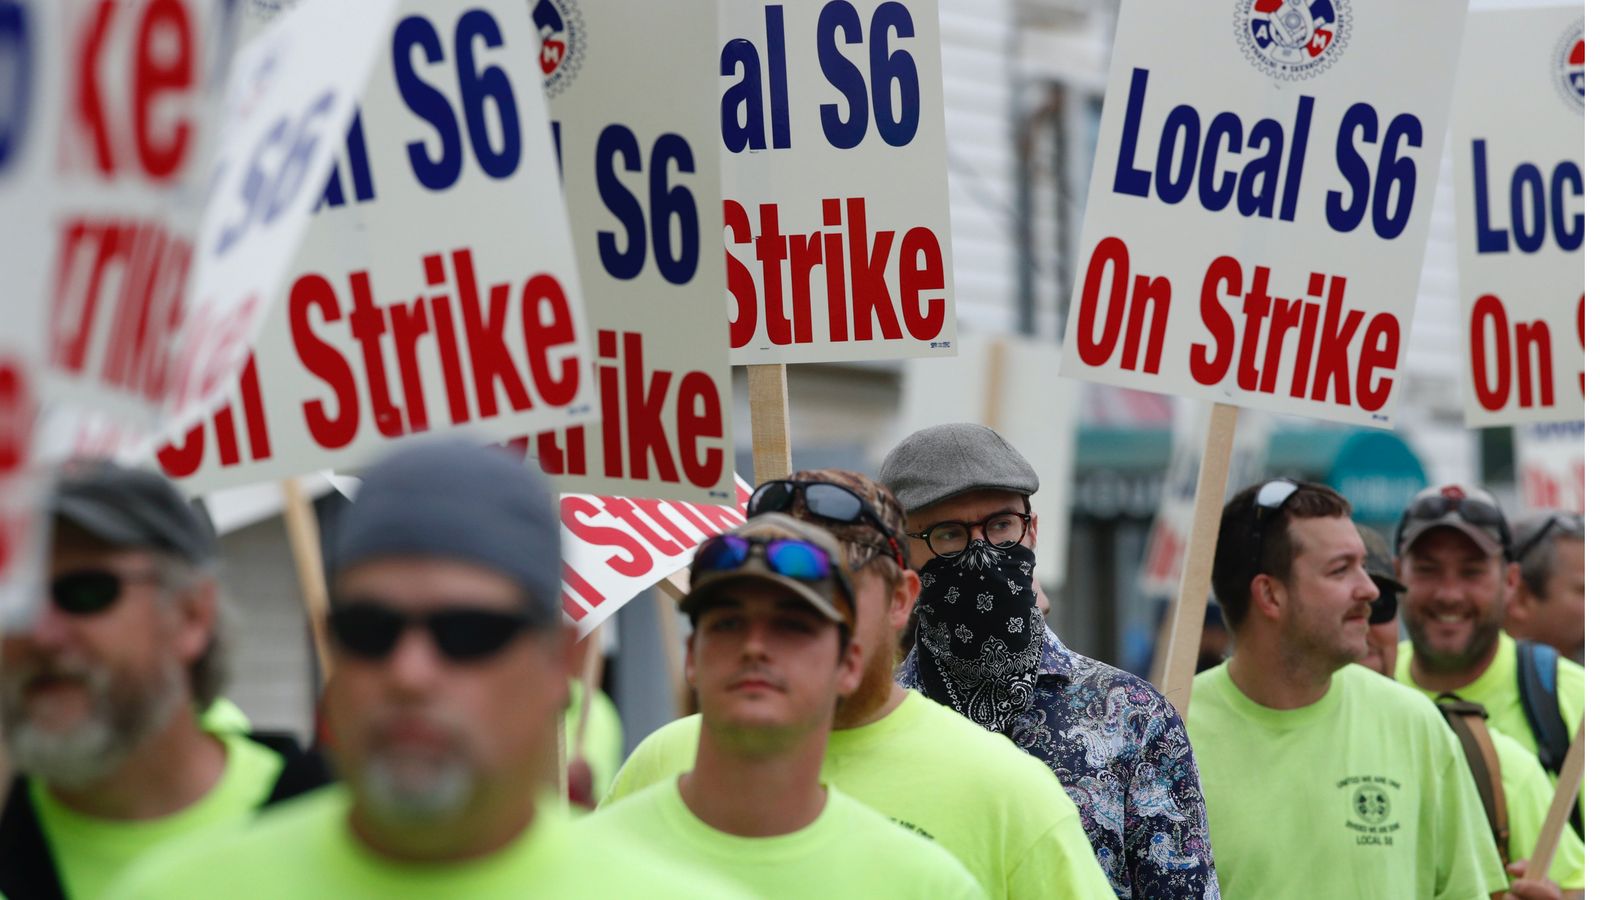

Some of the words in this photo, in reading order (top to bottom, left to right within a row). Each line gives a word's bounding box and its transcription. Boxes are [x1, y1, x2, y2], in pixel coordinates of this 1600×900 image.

[393, 8, 522, 191] S6
[817, 0, 920, 149] S6
[1113, 67, 1315, 222] Local
[1325, 102, 1423, 240] S6
[595, 123, 701, 285] S6
[722, 197, 946, 348] Strike
[1472, 139, 1585, 254] Loc
[288, 248, 580, 450] Strike
[1076, 236, 1172, 375] On
[1189, 255, 1401, 412] Strike
[1470, 293, 1555, 412] On
